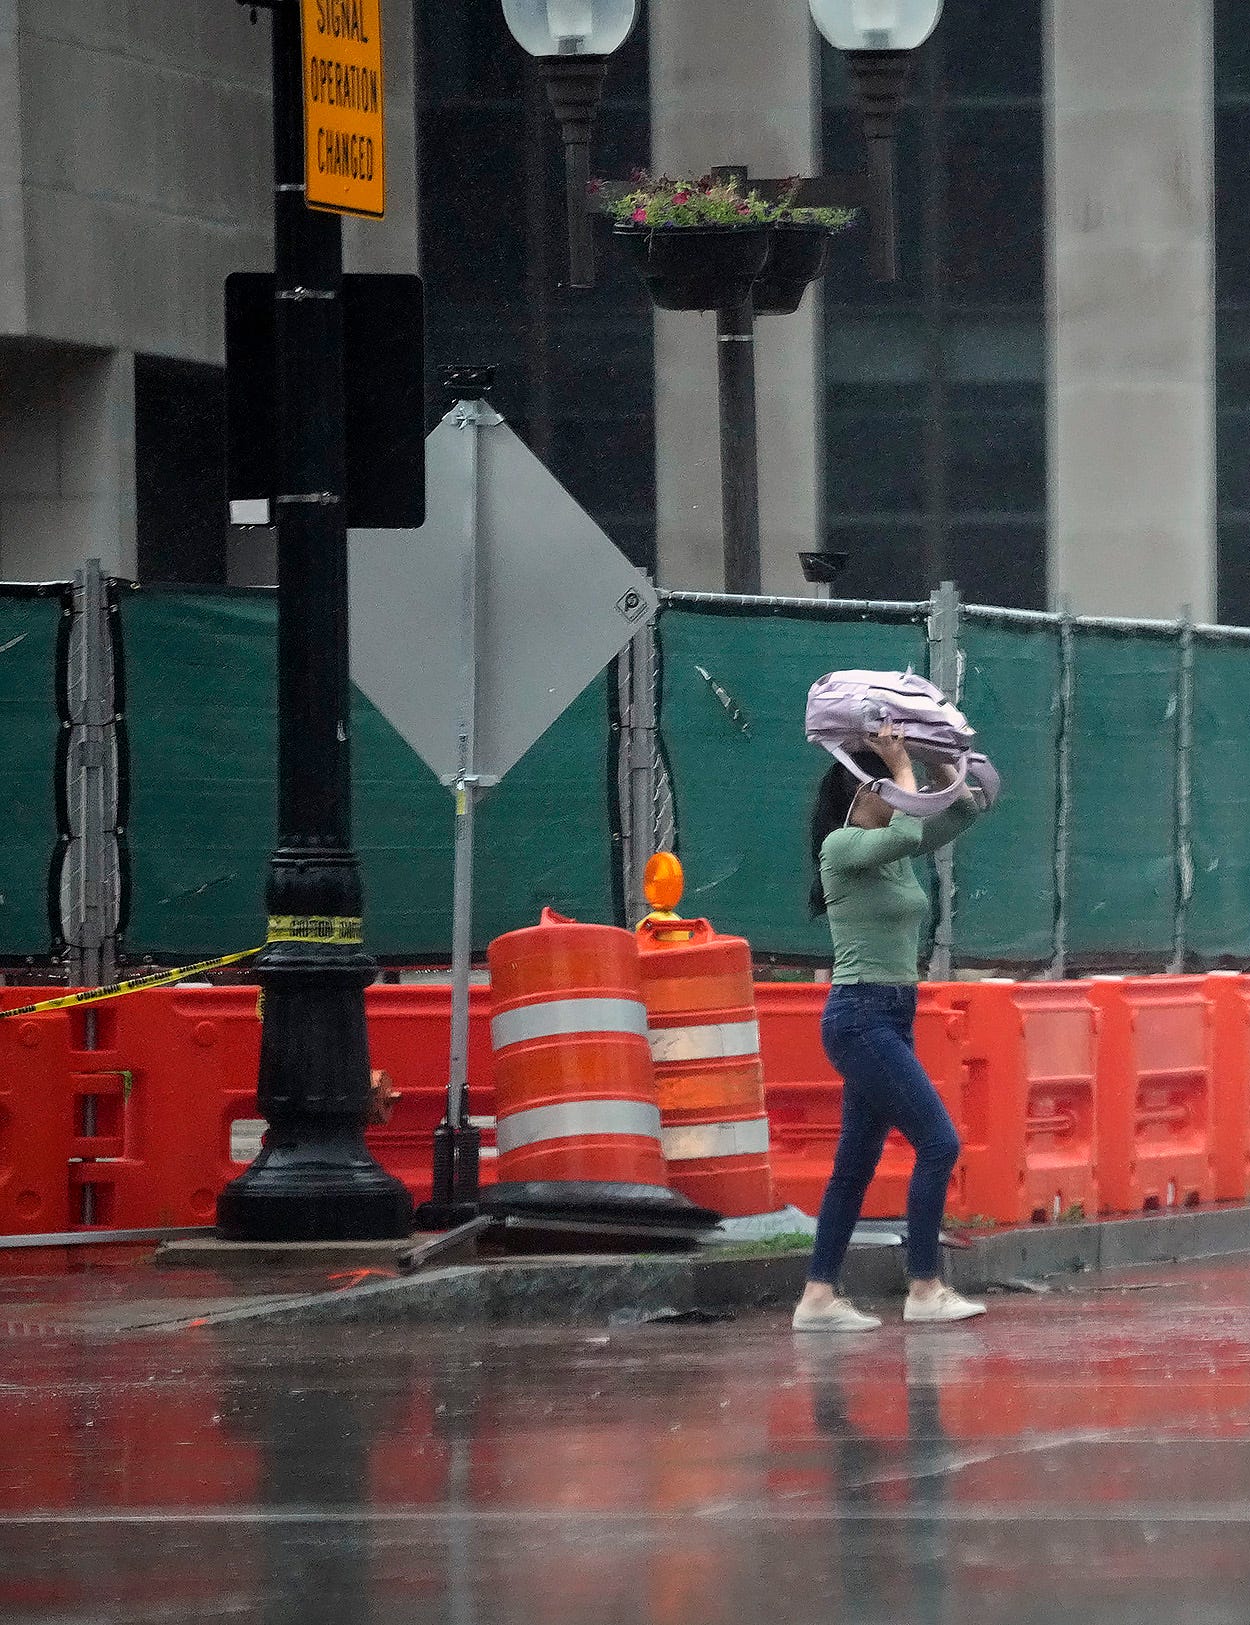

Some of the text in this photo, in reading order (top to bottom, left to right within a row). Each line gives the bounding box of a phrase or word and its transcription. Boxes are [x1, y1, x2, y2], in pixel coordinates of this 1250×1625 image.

[317, 0, 368, 43] SIGNAL
[310, 56, 377, 113] OPERATION
[317, 127, 373, 180] CHANGED
